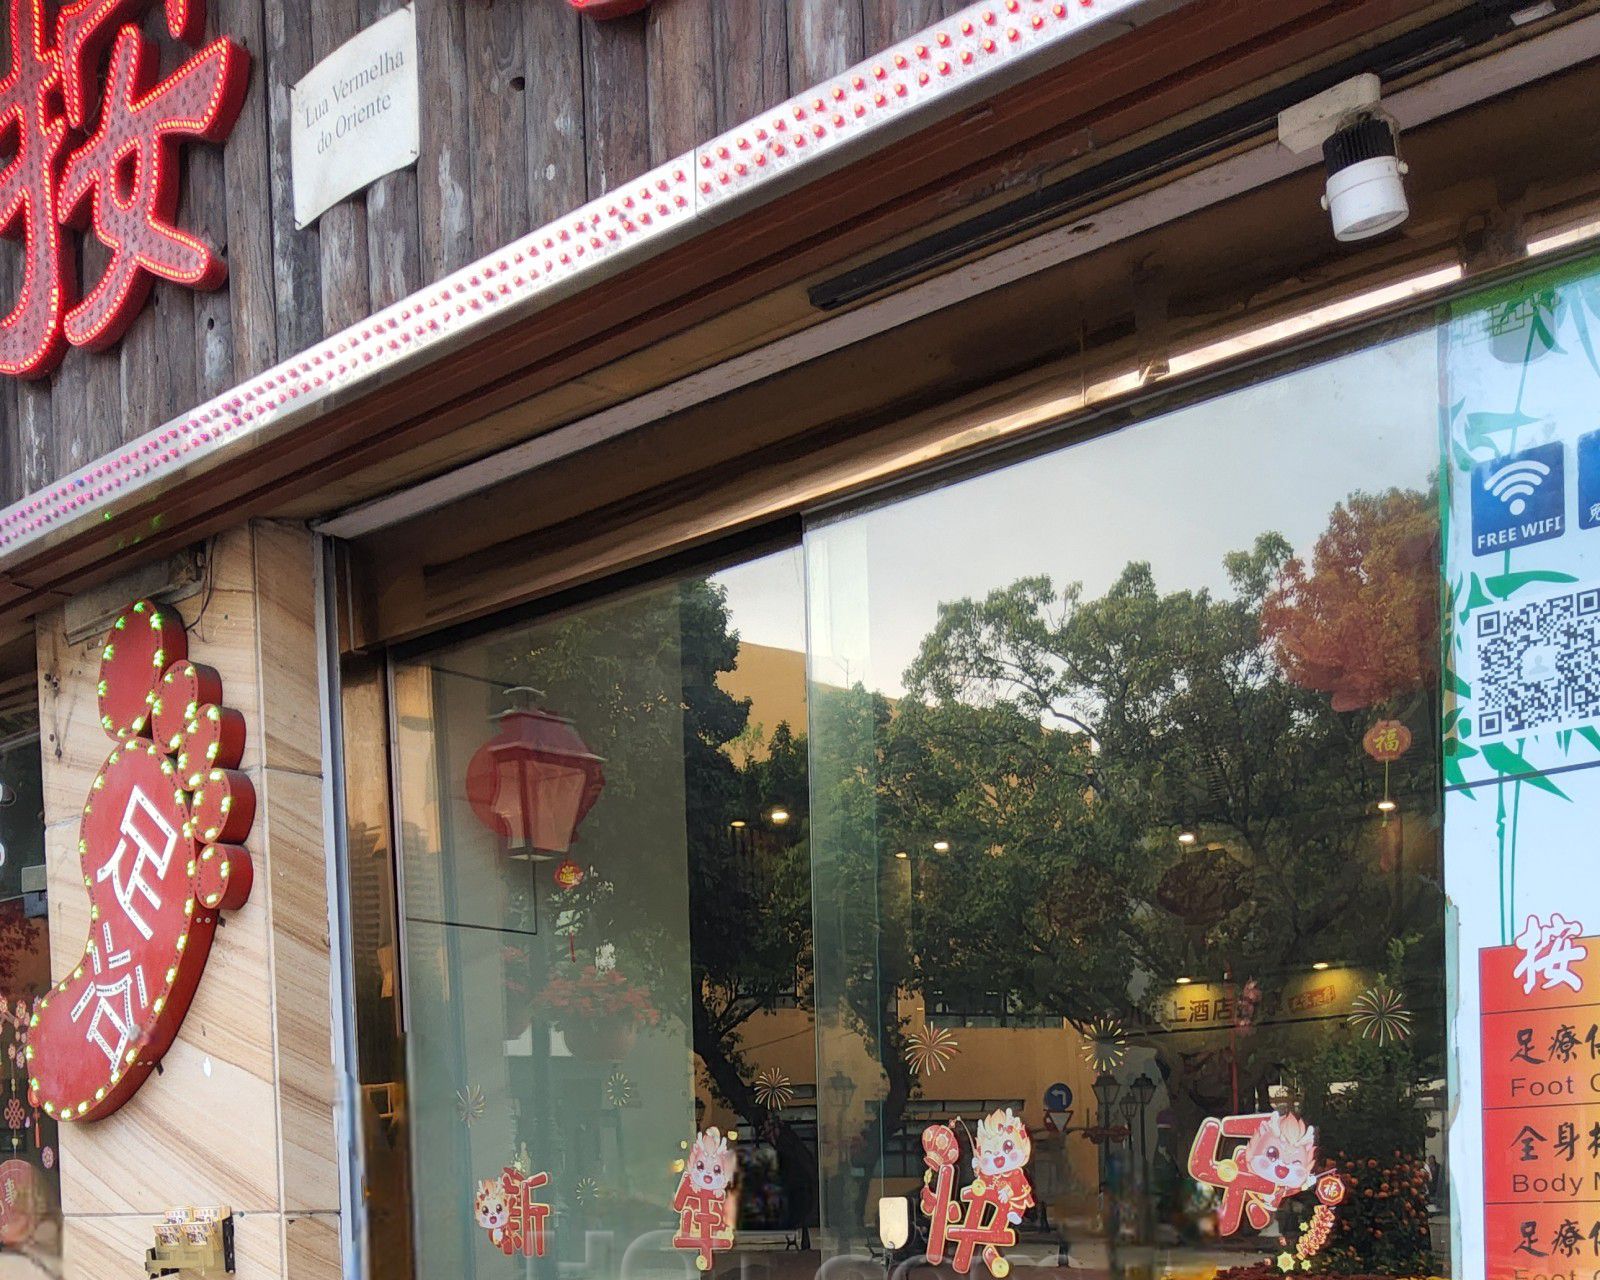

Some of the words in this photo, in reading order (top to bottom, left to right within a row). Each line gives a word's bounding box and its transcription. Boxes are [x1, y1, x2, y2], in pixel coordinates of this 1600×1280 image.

[305, 98, 329, 128] Lua
[332, 50, 404, 103] Vermelha
[317, 131, 332, 154] do
[335, 93, 391, 139] Oriente
[1477, 527, 1517, 549] FREE
[1521, 516, 1561, 538] WIFI
[1512, 912, 1588, 996] 按
[1511, 1075, 1574, 1097] Foot
[1513, 1172, 1584, 1197] Body
